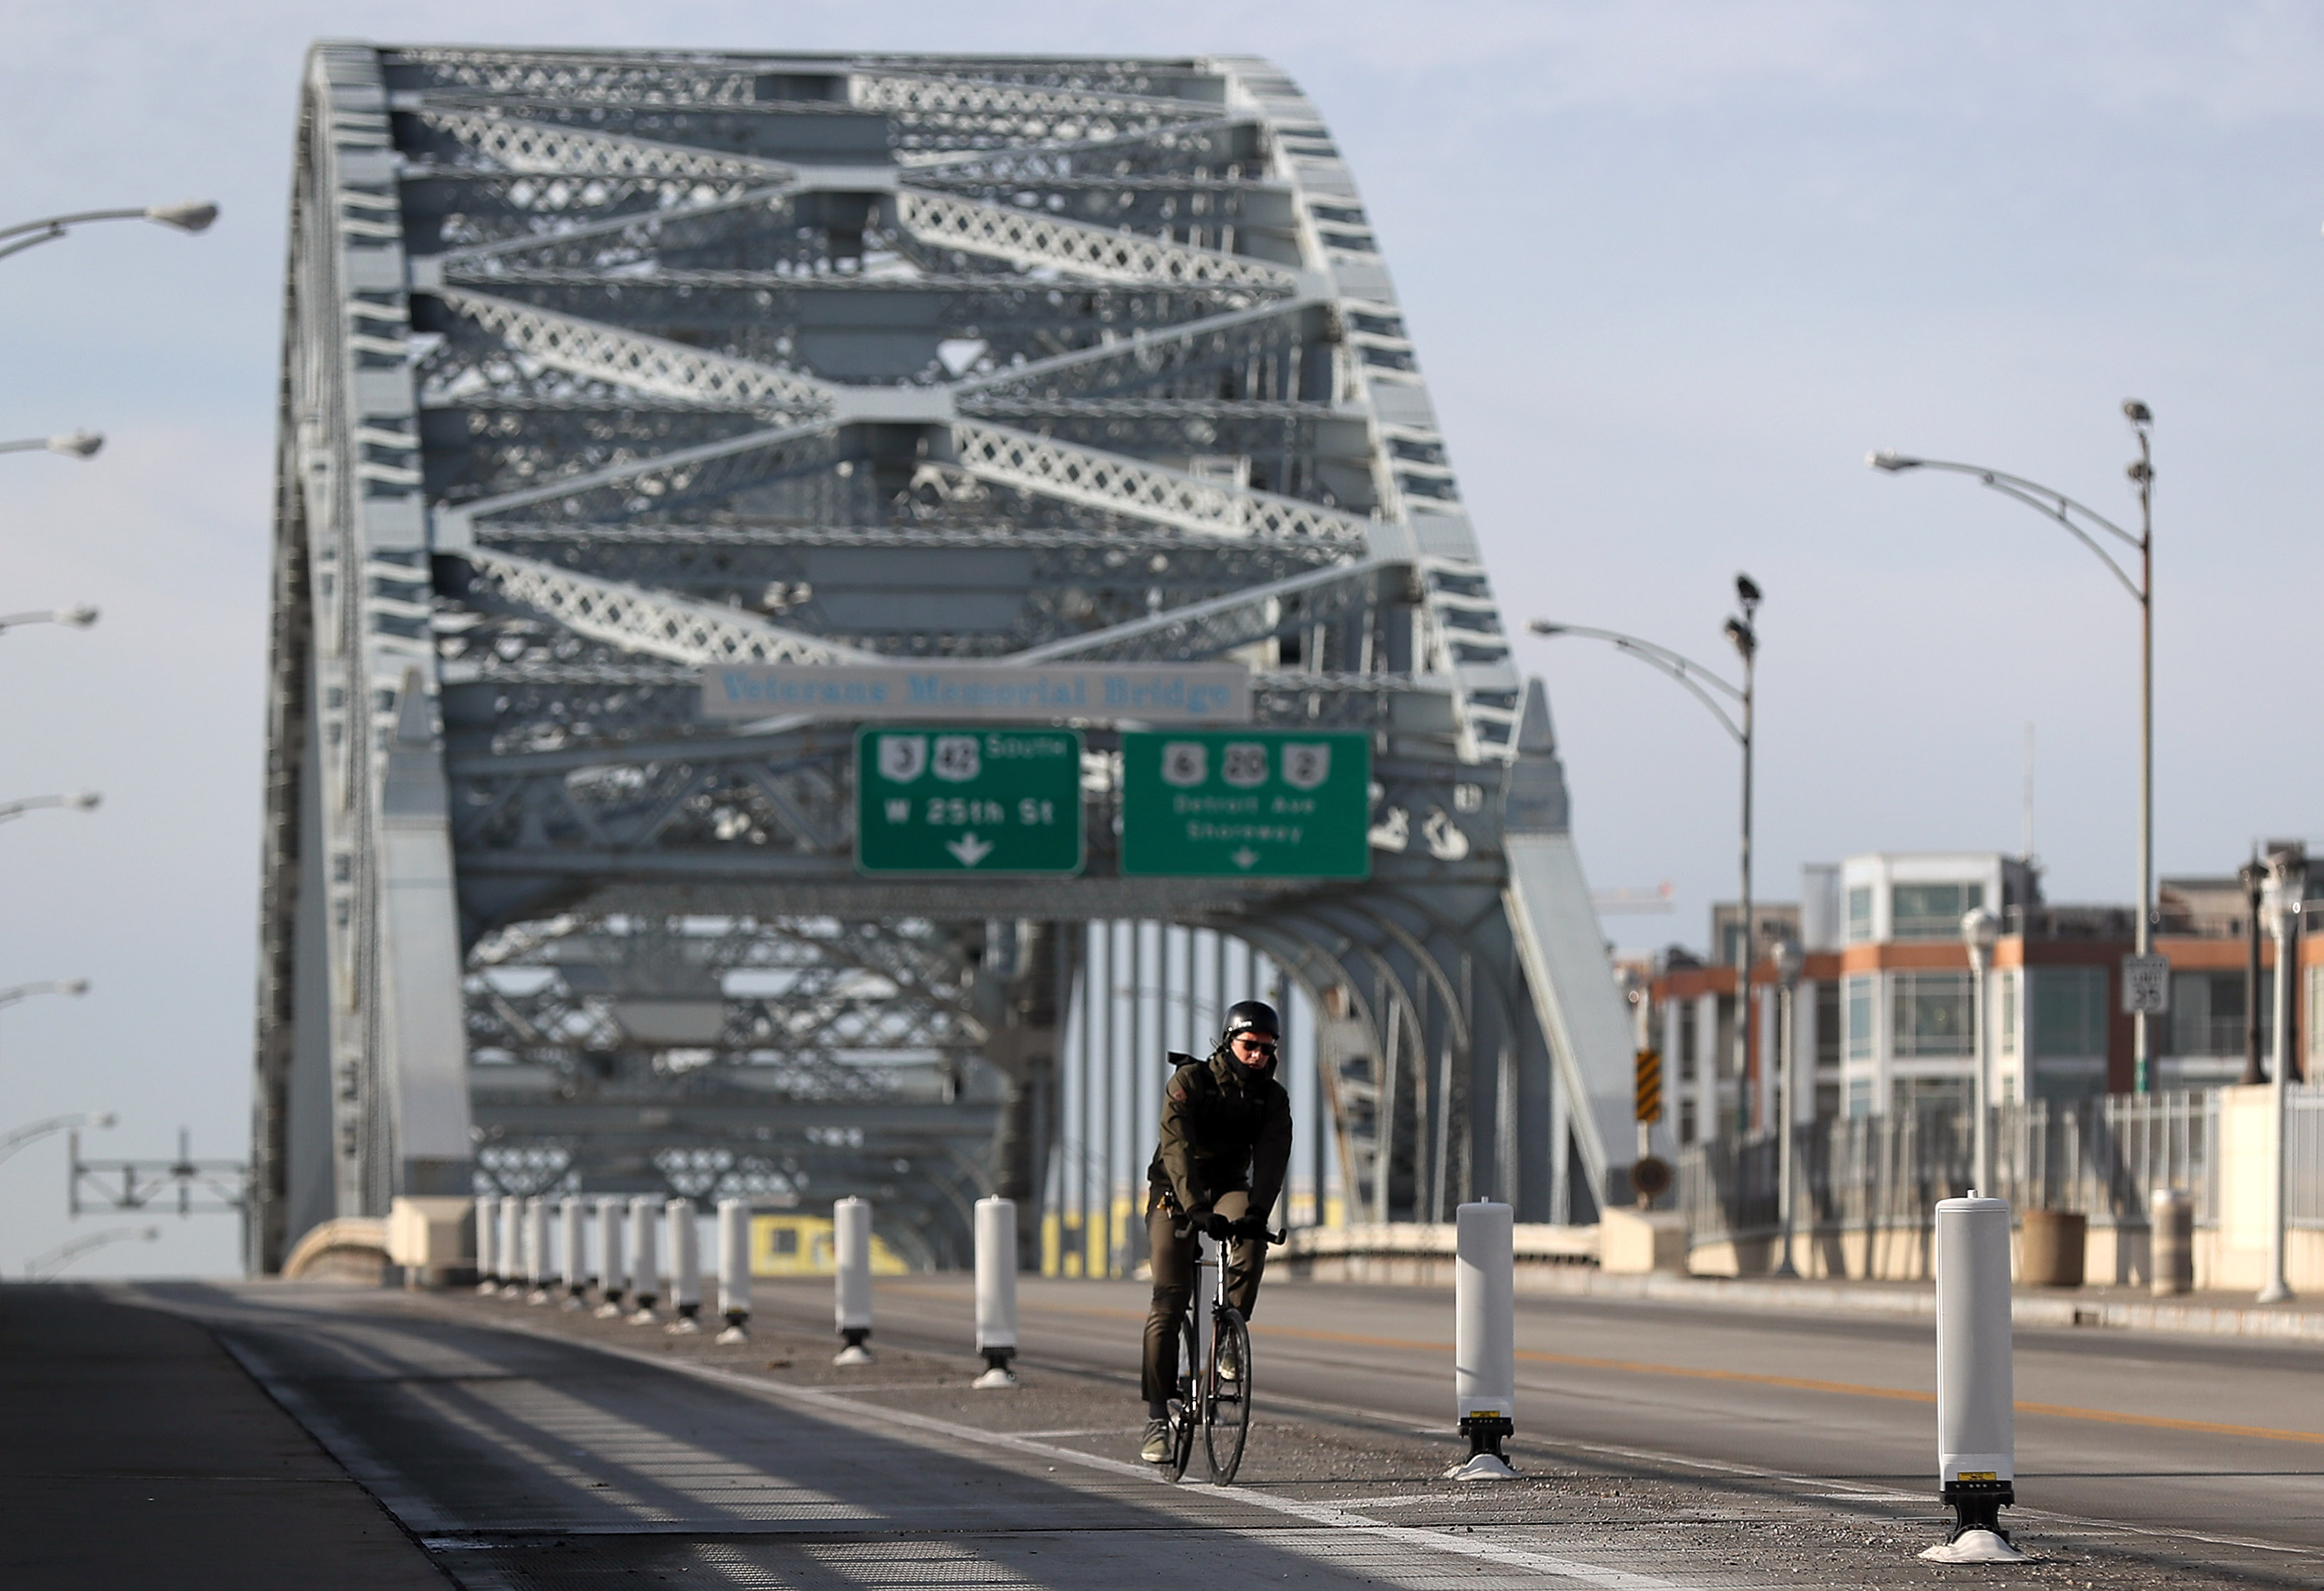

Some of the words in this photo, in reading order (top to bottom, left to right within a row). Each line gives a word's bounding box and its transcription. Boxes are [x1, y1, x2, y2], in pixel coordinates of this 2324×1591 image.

[722, 672, 888, 705] Veterans
[906, 674, 1087, 705] Memorial
[1104, 677, 1231, 715] Bridge
[893, 740, 914, 773] 3
[938, 743, 973, 772] 42
[1173, 751, 1194, 778] 6
[1228, 750, 1265, 779] 20
[1296, 751, 1317, 780] 2
[885, 799, 910, 823] W
[926, 798, 1004, 824] 25th
[1018, 798, 1053, 824] St
[1173, 794, 1258, 814] Detroit
[1272, 796, 1315, 814] Ave
[1187, 822, 1303, 846] Shoreway
